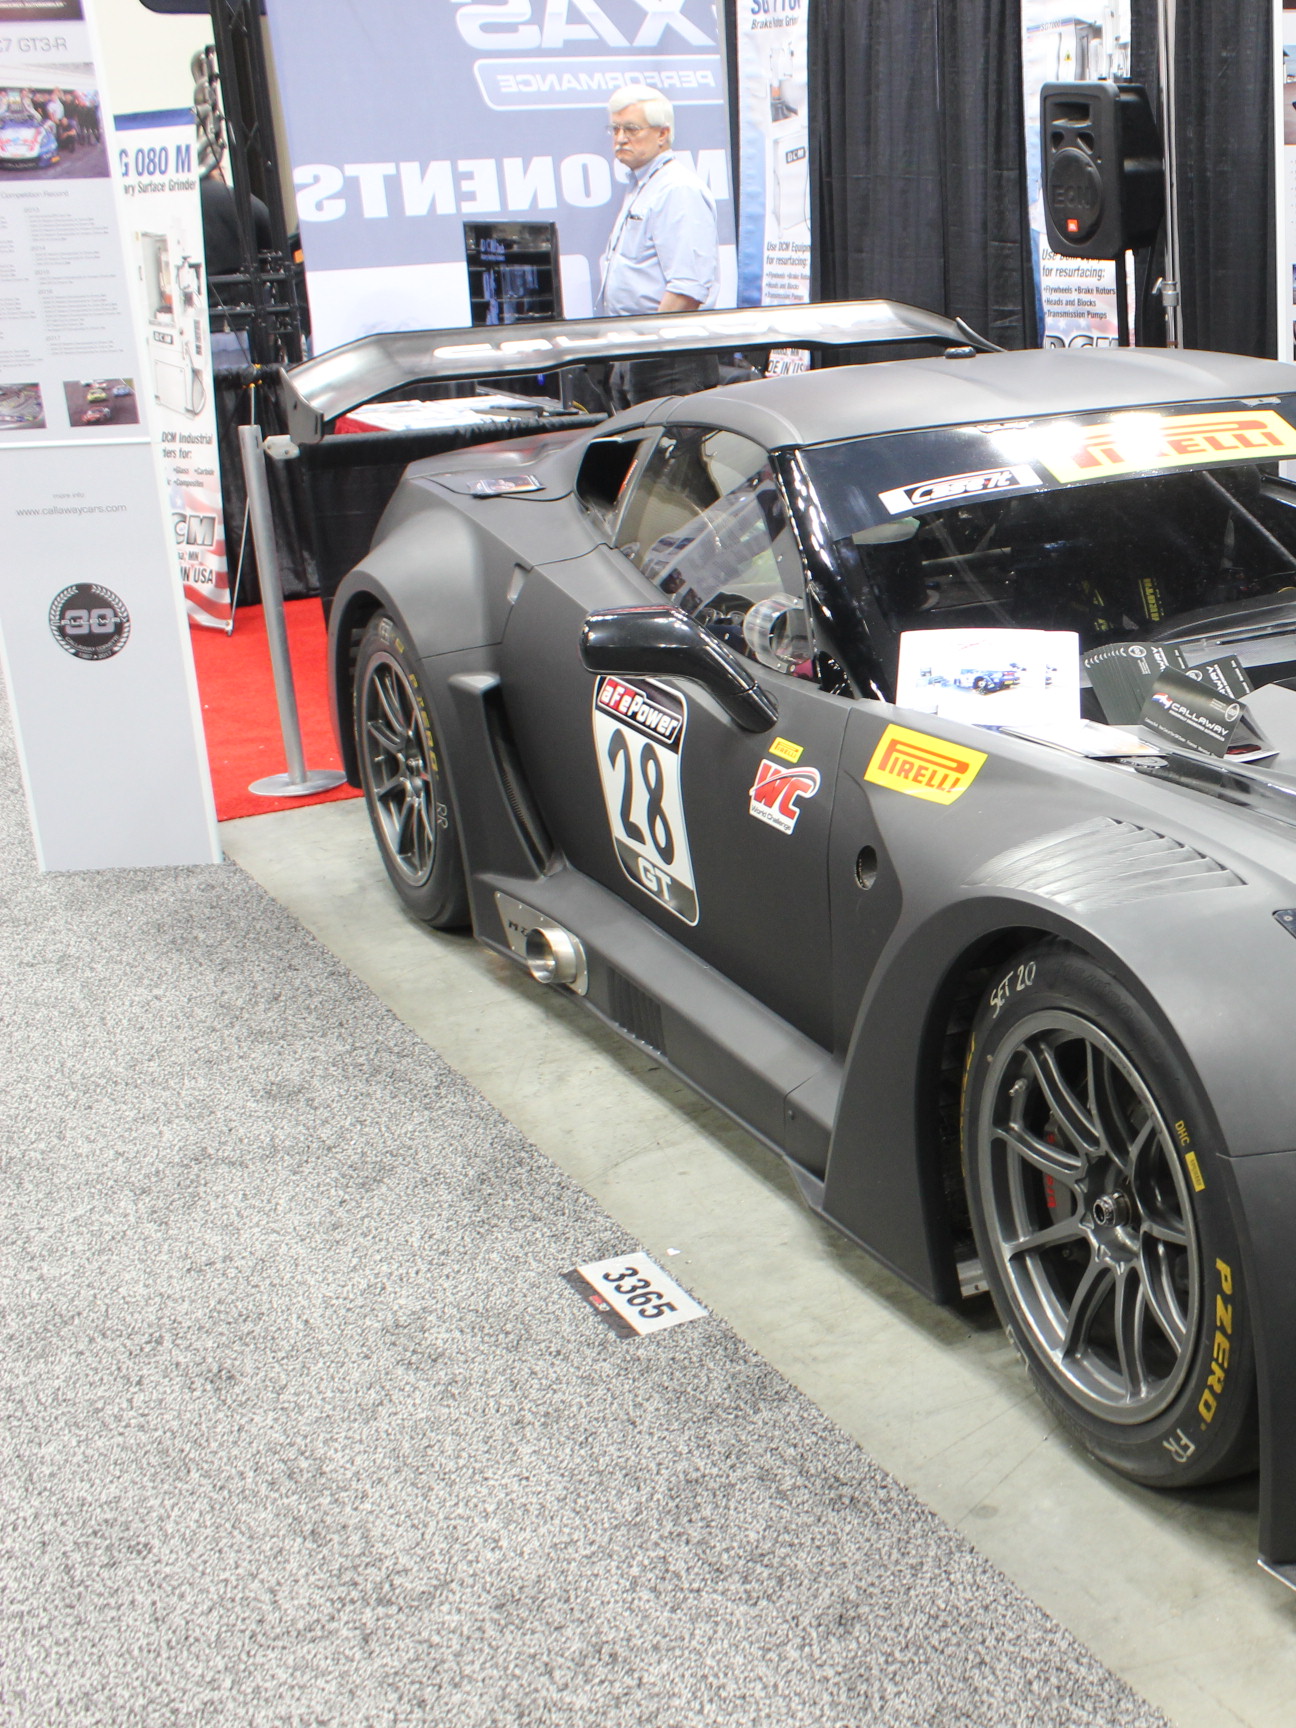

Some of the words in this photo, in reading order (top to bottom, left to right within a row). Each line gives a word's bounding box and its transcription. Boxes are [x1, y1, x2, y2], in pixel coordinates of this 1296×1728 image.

[18, 37, 68, 53] GT3-R
[135, 146, 169, 177] 080
[175, 143, 192, 174] M
[168, 178, 197, 192] Grinder
[1042, 264, 1053, 278] for
[1055, 264, 1106, 281] resurfacing:
[1045, 286, 1073, 296] Flywheels
[1077, 286, 1095, 296] Brake
[1095, 287, 1117, 297] Rotors
[1046, 298, 1064, 307] Heads
[1065, 298, 1076, 307] and
[1077, 298, 1097, 307] Blocks
[1047, 309, 1086, 319] Transmission
[1086, 310, 1108, 321] Pumps
[161, 431, 177, 444] DCM
[178, 431, 213, 445] Industrial
[1072, 419, 1285, 469] PIELLI
[178, 449, 193, 460] for:
[15, 503, 128, 518] www.callawaycars.com
[193, 567, 214, 585] USA
[1171, 702, 1230, 736] CALLAWAY
[774, 740, 800, 759] PIRELLI
[877, 738, 971, 795] PIRELLI
[607, 728, 676, 866] 28
[752, 762, 813, 821] WC
[750, 803, 768, 819] World
[767, 811, 792, 832] Challenge
[637, 856, 673, 901] GT
[1015, 961, 1037, 993] 20
[1174, 1120, 1190, 1147] DHC
[602, 1266, 679, 1319] 3365
[1162, 1427, 1196, 1463] FR
